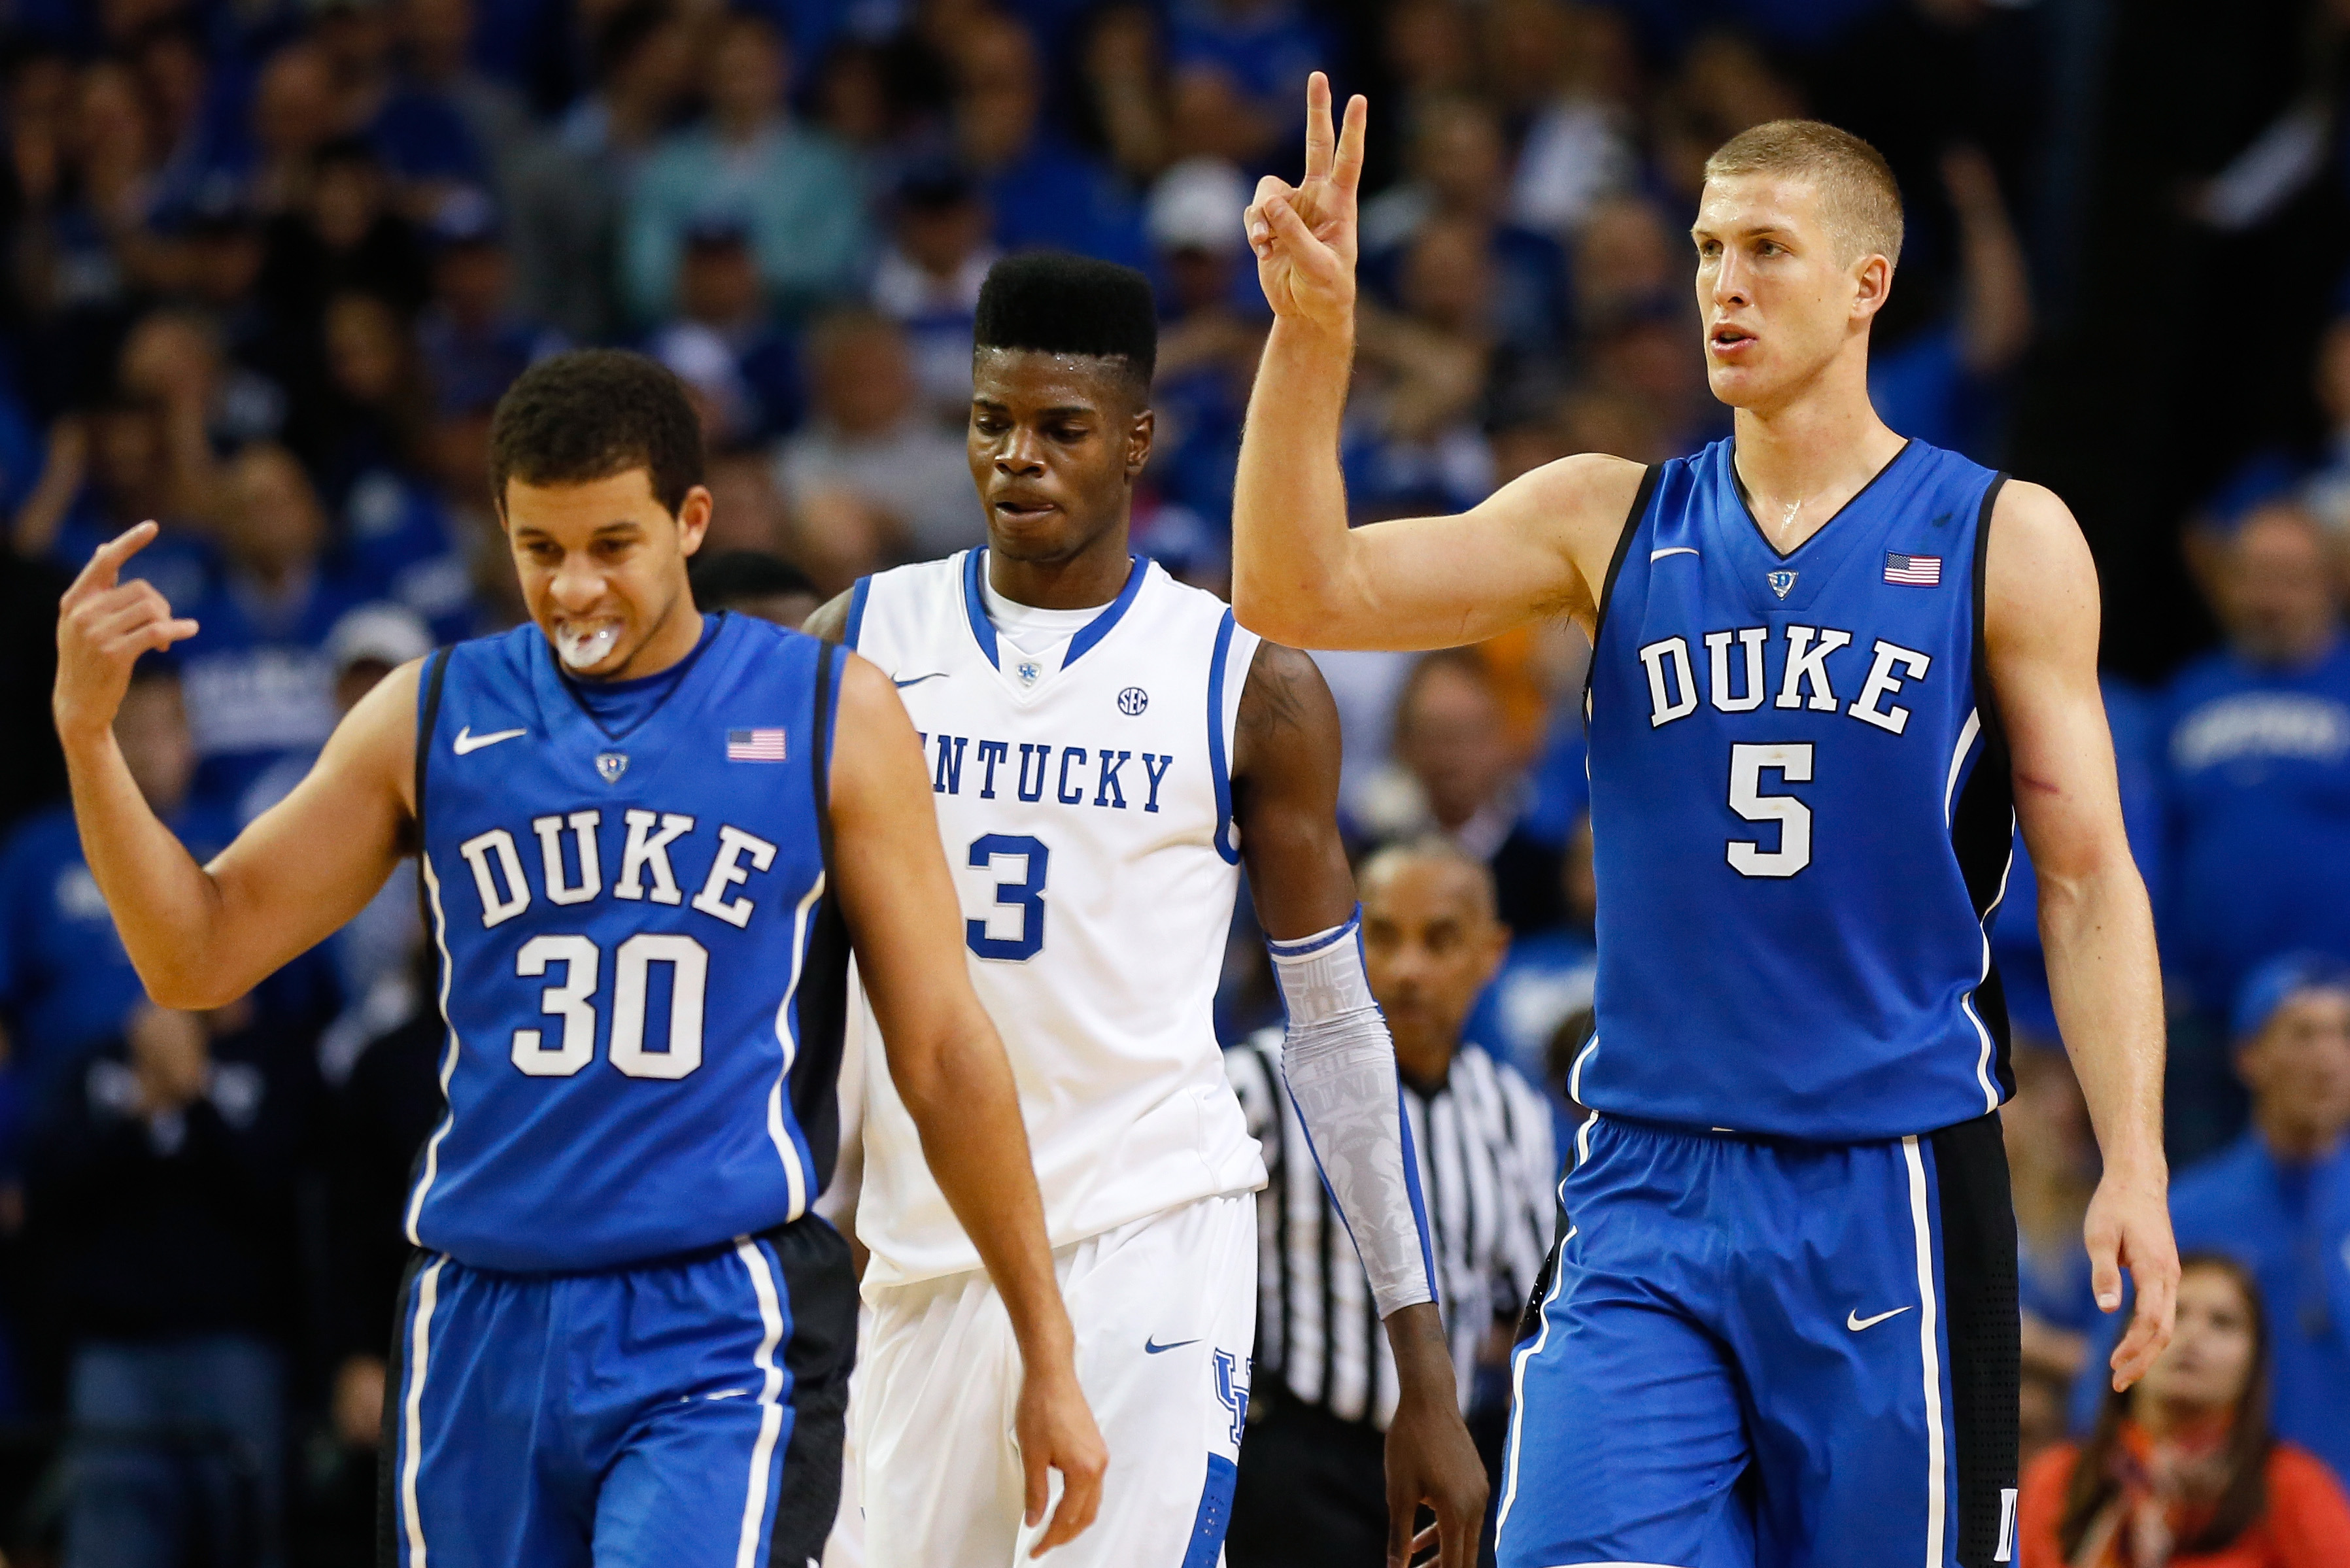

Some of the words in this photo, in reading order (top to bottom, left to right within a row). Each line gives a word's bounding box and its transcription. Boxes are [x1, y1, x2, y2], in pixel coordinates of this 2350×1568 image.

[1118, 687, 1148, 715] SEC
[1639, 625, 1931, 735] DUKE
[916, 731, 1173, 813] NTUCKY
[1727, 743, 1813, 877] 5
[460, 808, 778, 929] DUKE
[965, 833, 1050, 964] 3
[511, 933, 709, 1080] 30
